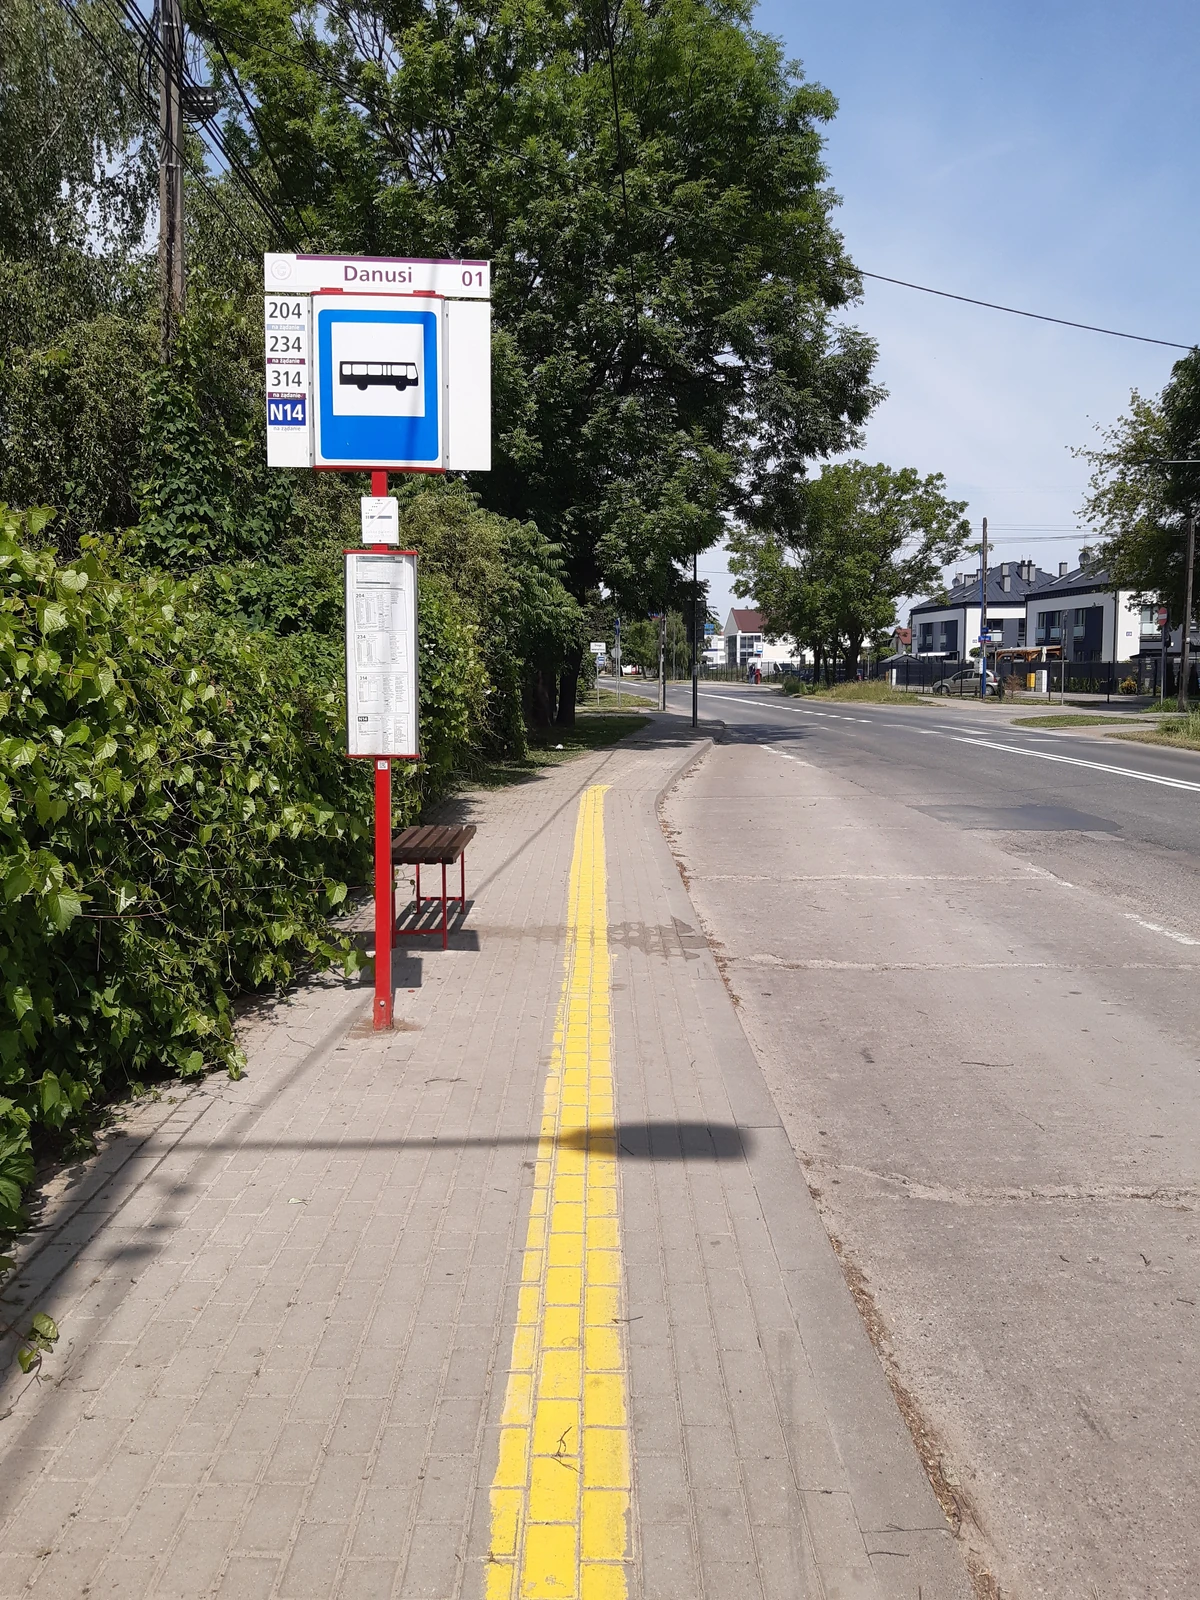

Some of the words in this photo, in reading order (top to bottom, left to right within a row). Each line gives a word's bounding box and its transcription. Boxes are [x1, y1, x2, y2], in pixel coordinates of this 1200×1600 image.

[343, 265, 413, 283] Danusi
[461, 270, 483, 287] 01
[268, 301, 302, 319] 204
[269, 335, 302, 353] 234
[271, 369, 302, 387] 314
[269, 403, 304, 421] N14
